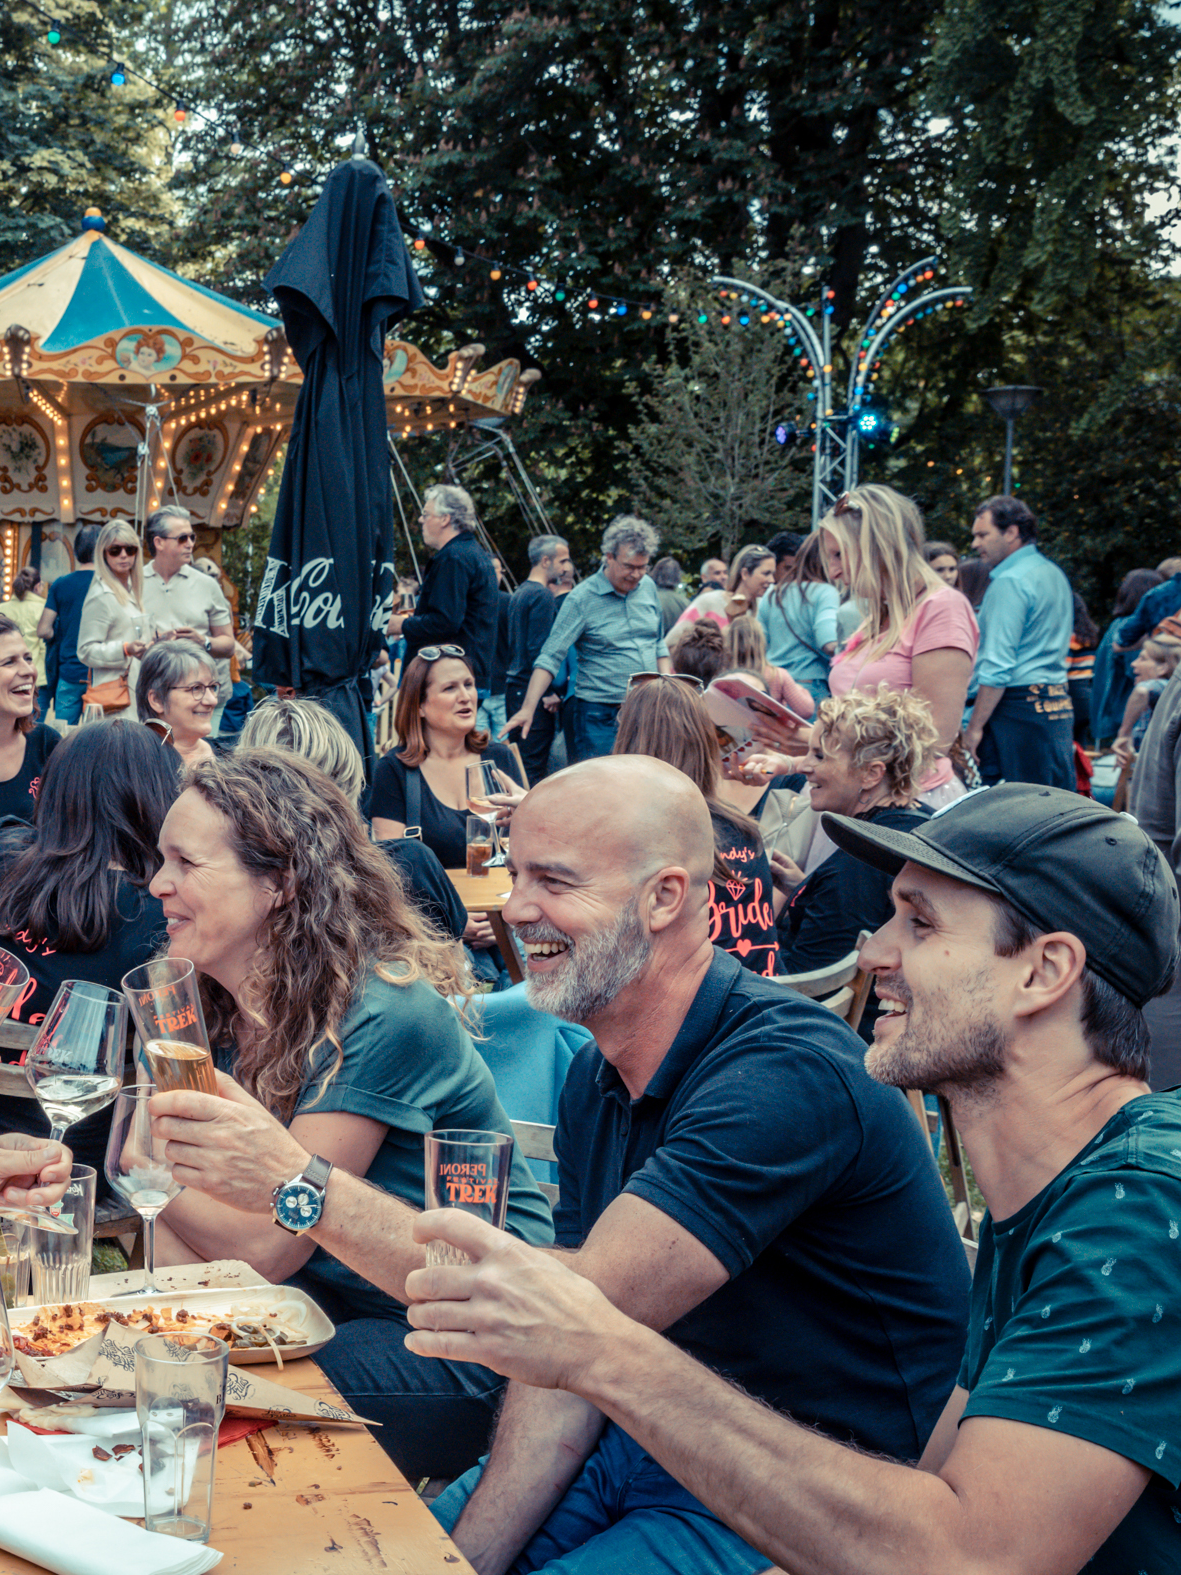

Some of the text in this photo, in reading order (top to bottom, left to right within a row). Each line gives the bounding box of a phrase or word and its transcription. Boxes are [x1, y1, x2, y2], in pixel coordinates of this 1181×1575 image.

[720, 846, 755, 862] ndy's
[154, 1008, 198, 1034] TREK
[446, 1182, 498, 1204] TREK
